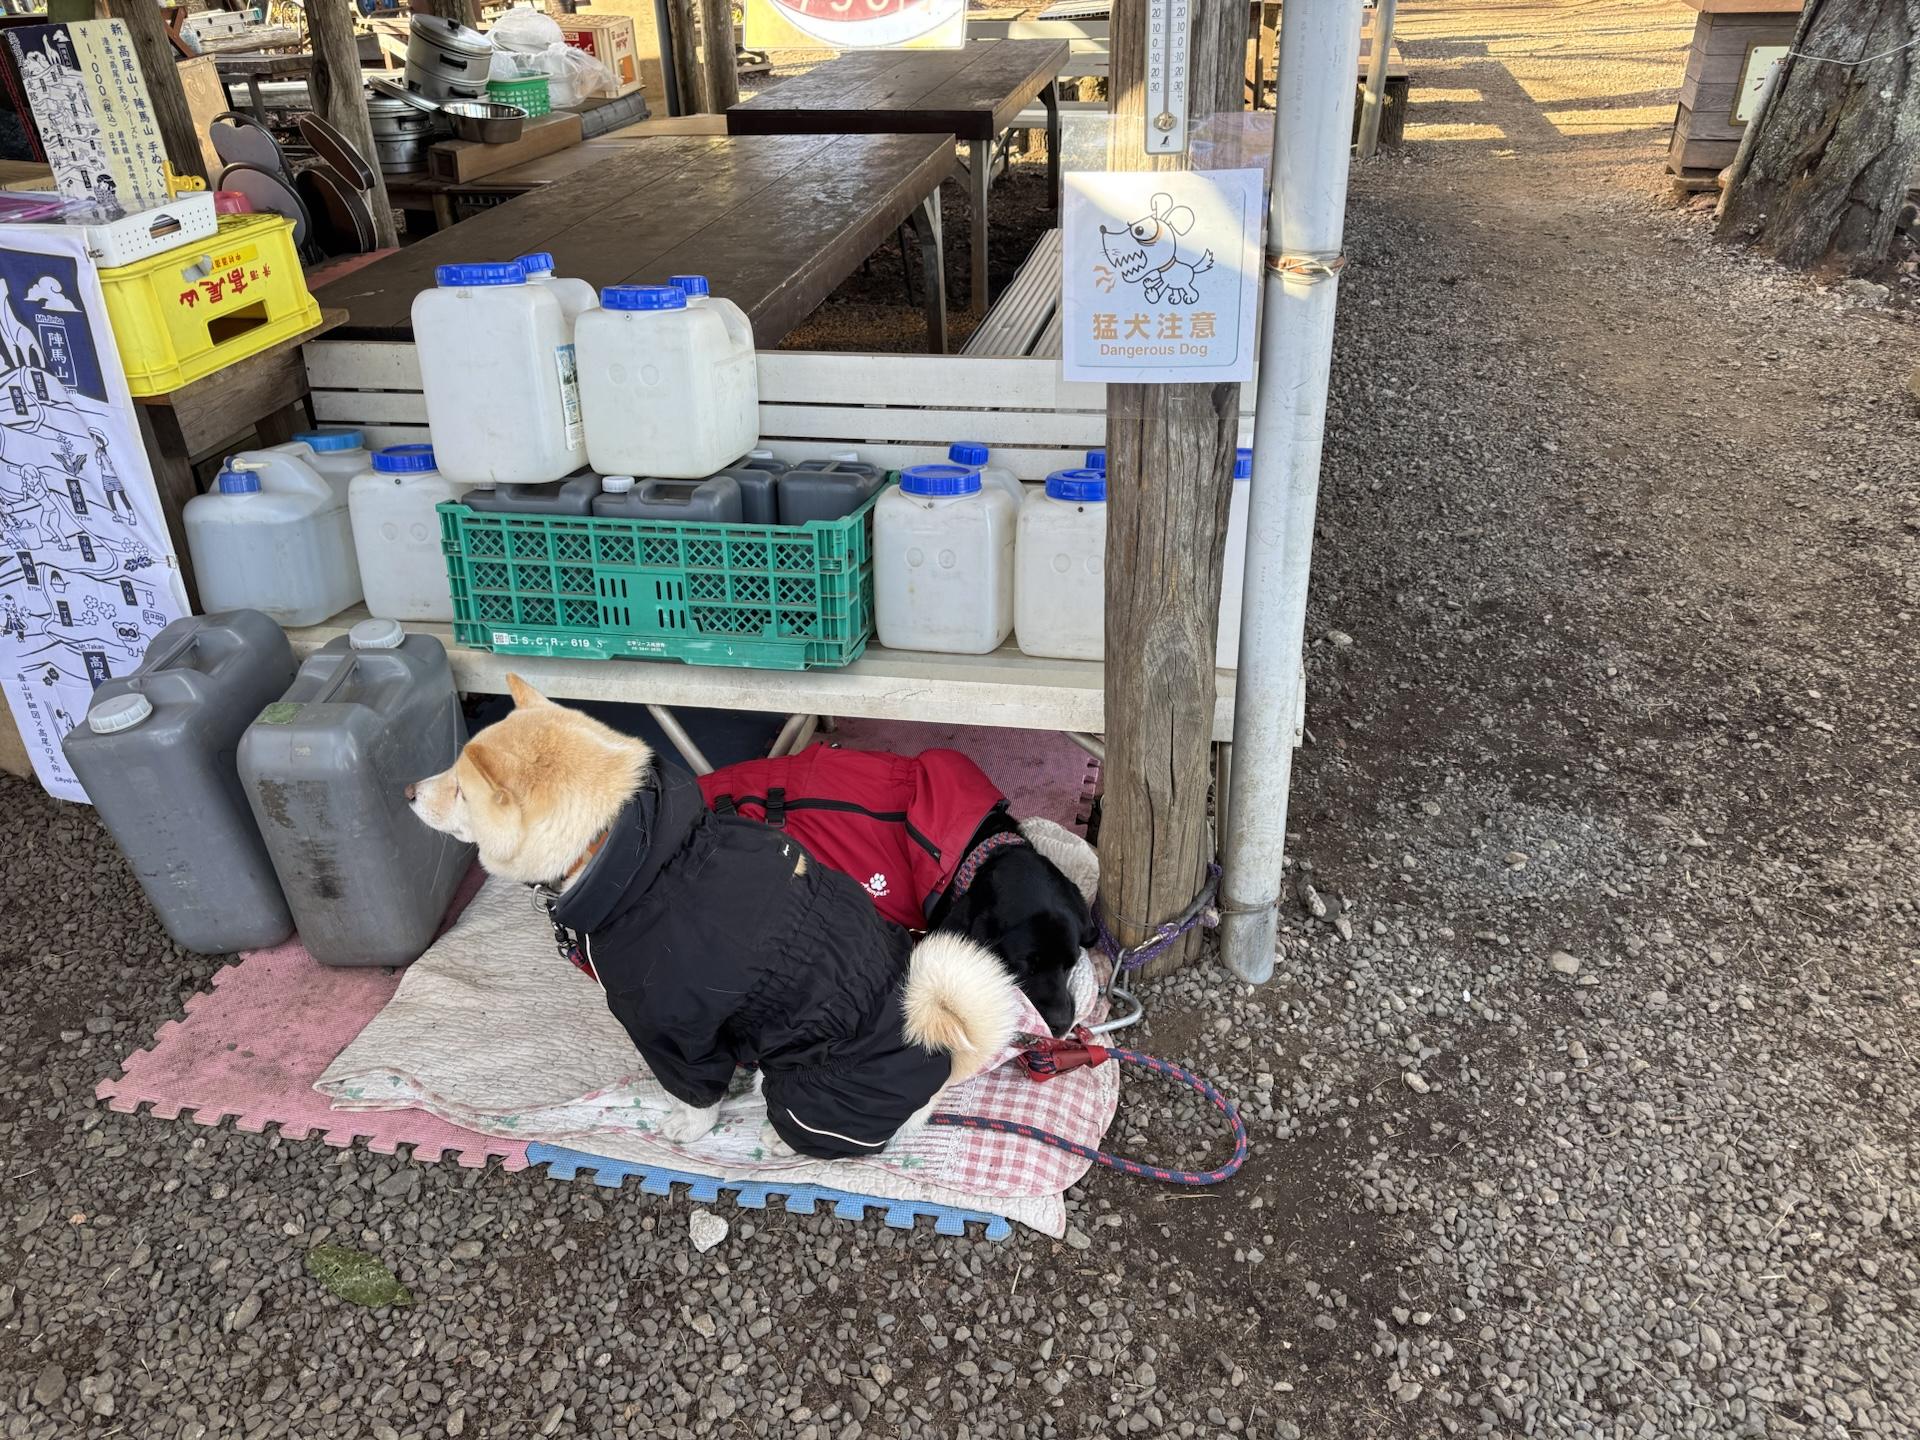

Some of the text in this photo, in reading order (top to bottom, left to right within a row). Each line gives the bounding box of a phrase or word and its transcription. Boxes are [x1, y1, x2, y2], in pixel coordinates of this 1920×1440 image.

[212, 251, 242, 270] 中村酒造
[179, 267, 248, 308] 高尾山
[1092, 312, 1217, 340] 猛犬注意
[47, 331, 69, 379] 陣馬山
[1100, 343, 1208, 358] Dangerous Dog
[571, 638, 590, 648] 619
[89, 655, 107, 681] 高尾
